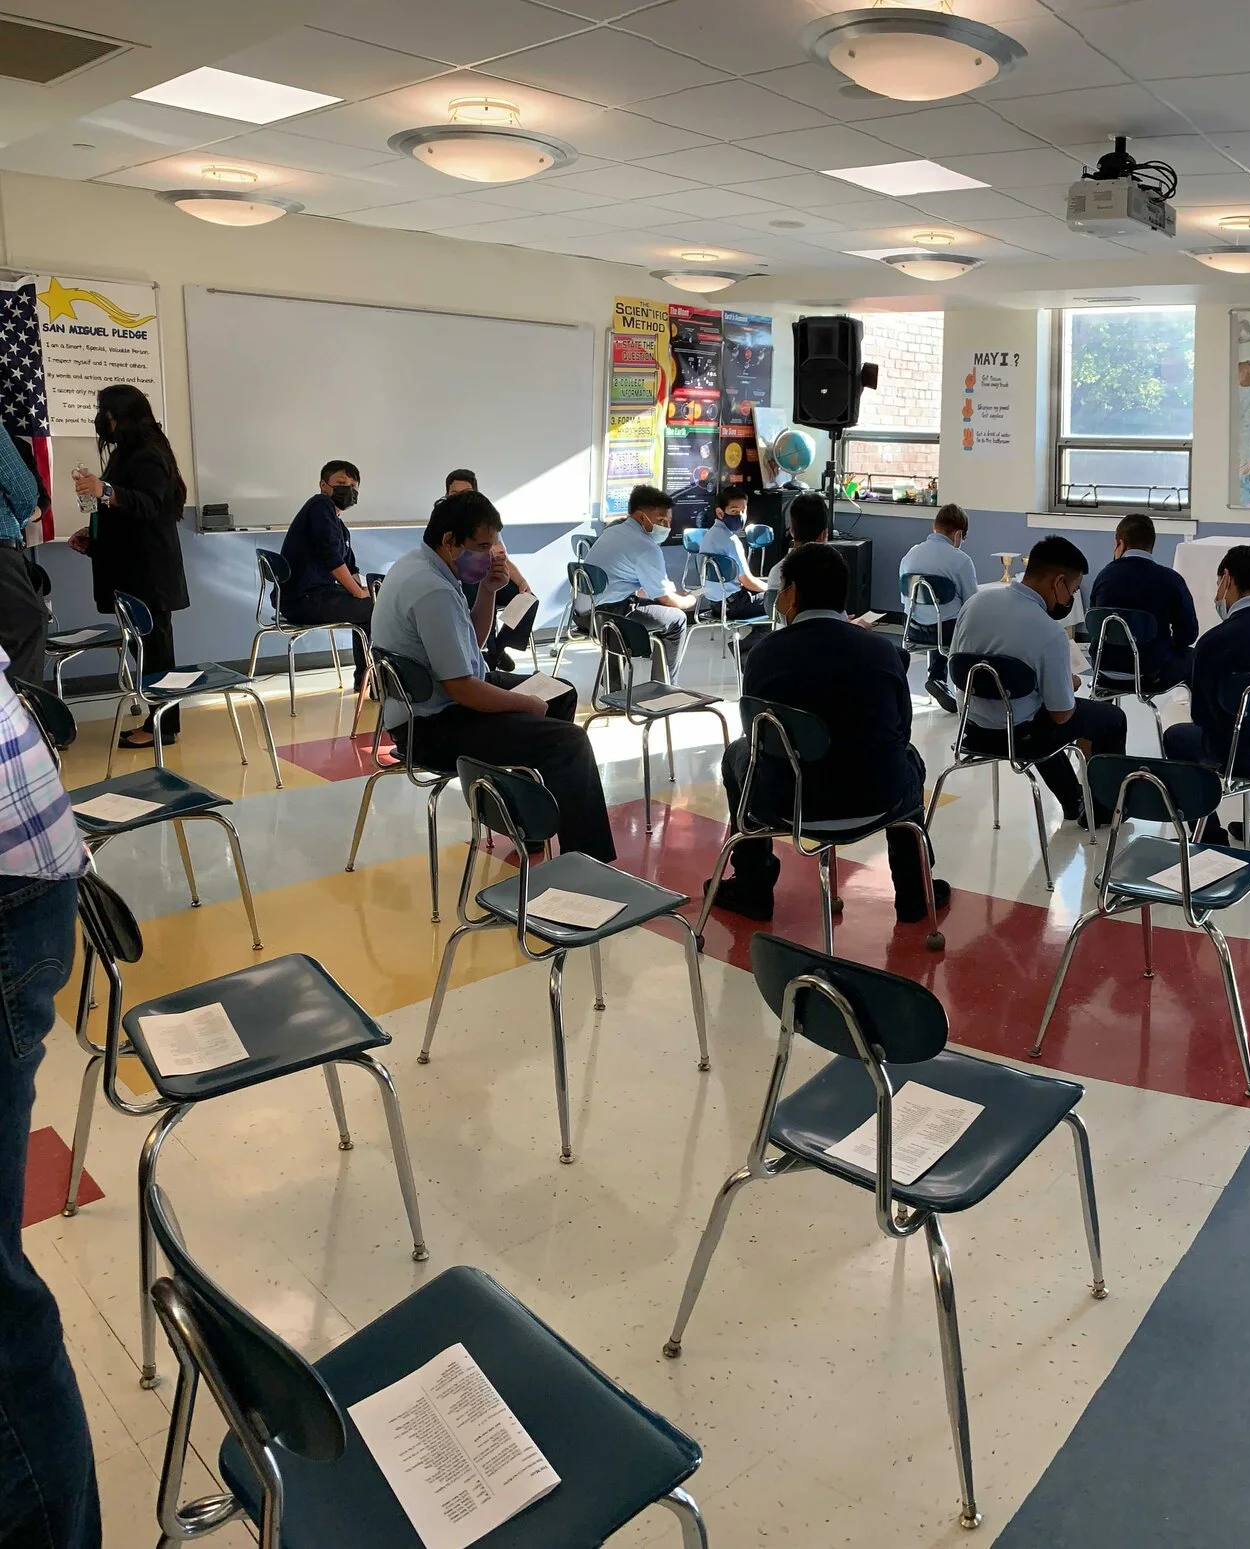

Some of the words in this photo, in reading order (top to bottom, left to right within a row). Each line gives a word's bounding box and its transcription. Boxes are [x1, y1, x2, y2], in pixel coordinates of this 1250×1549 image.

[616, 302, 668, 321] SCIENTIFIC
[42, 323, 65, 333] SAN
[69, 325, 109, 337] MIGUEL
[112, 328, 147, 340] PLEDGE
[622, 316, 665, 332] METHOD
[622, 341, 641, 349] STATE
[643, 342, 654, 350] THE
[974, 352, 999, 365] MAY
[1000, 353, 1008, 366] I
